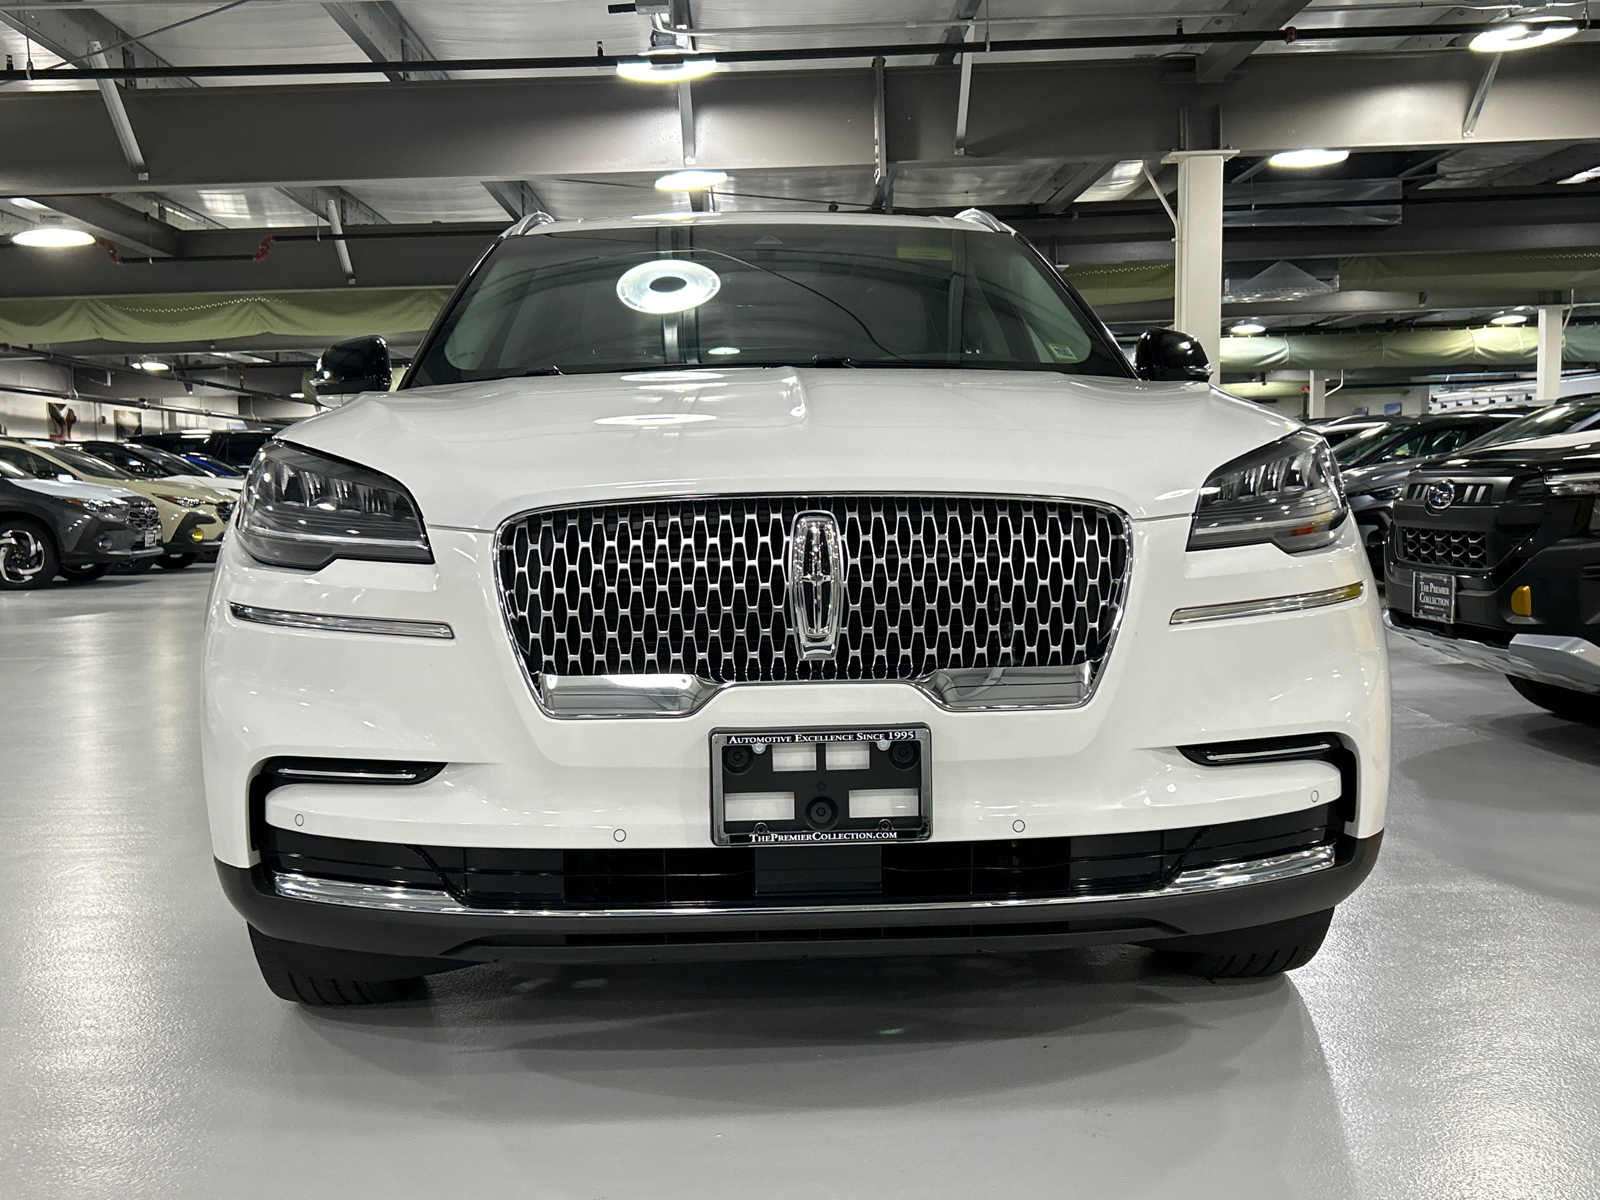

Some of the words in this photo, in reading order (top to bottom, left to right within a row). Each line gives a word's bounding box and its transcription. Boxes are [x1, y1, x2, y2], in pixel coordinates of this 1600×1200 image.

[1420, 582, 1430, 592] THE
[1430, 582, 1450, 594] PREMIER
[1420, 592, 1450, 606] COLLECTION
[729, 735, 792, 744] AUTOMOTIVE
[794, 734, 854, 743] EXCELLENCE
[856, 732, 885, 741] SINCE
[888, 730, 914, 740] 1995
[749, 831, 898, 843] THEPREMIERCOLLECTION.COM
